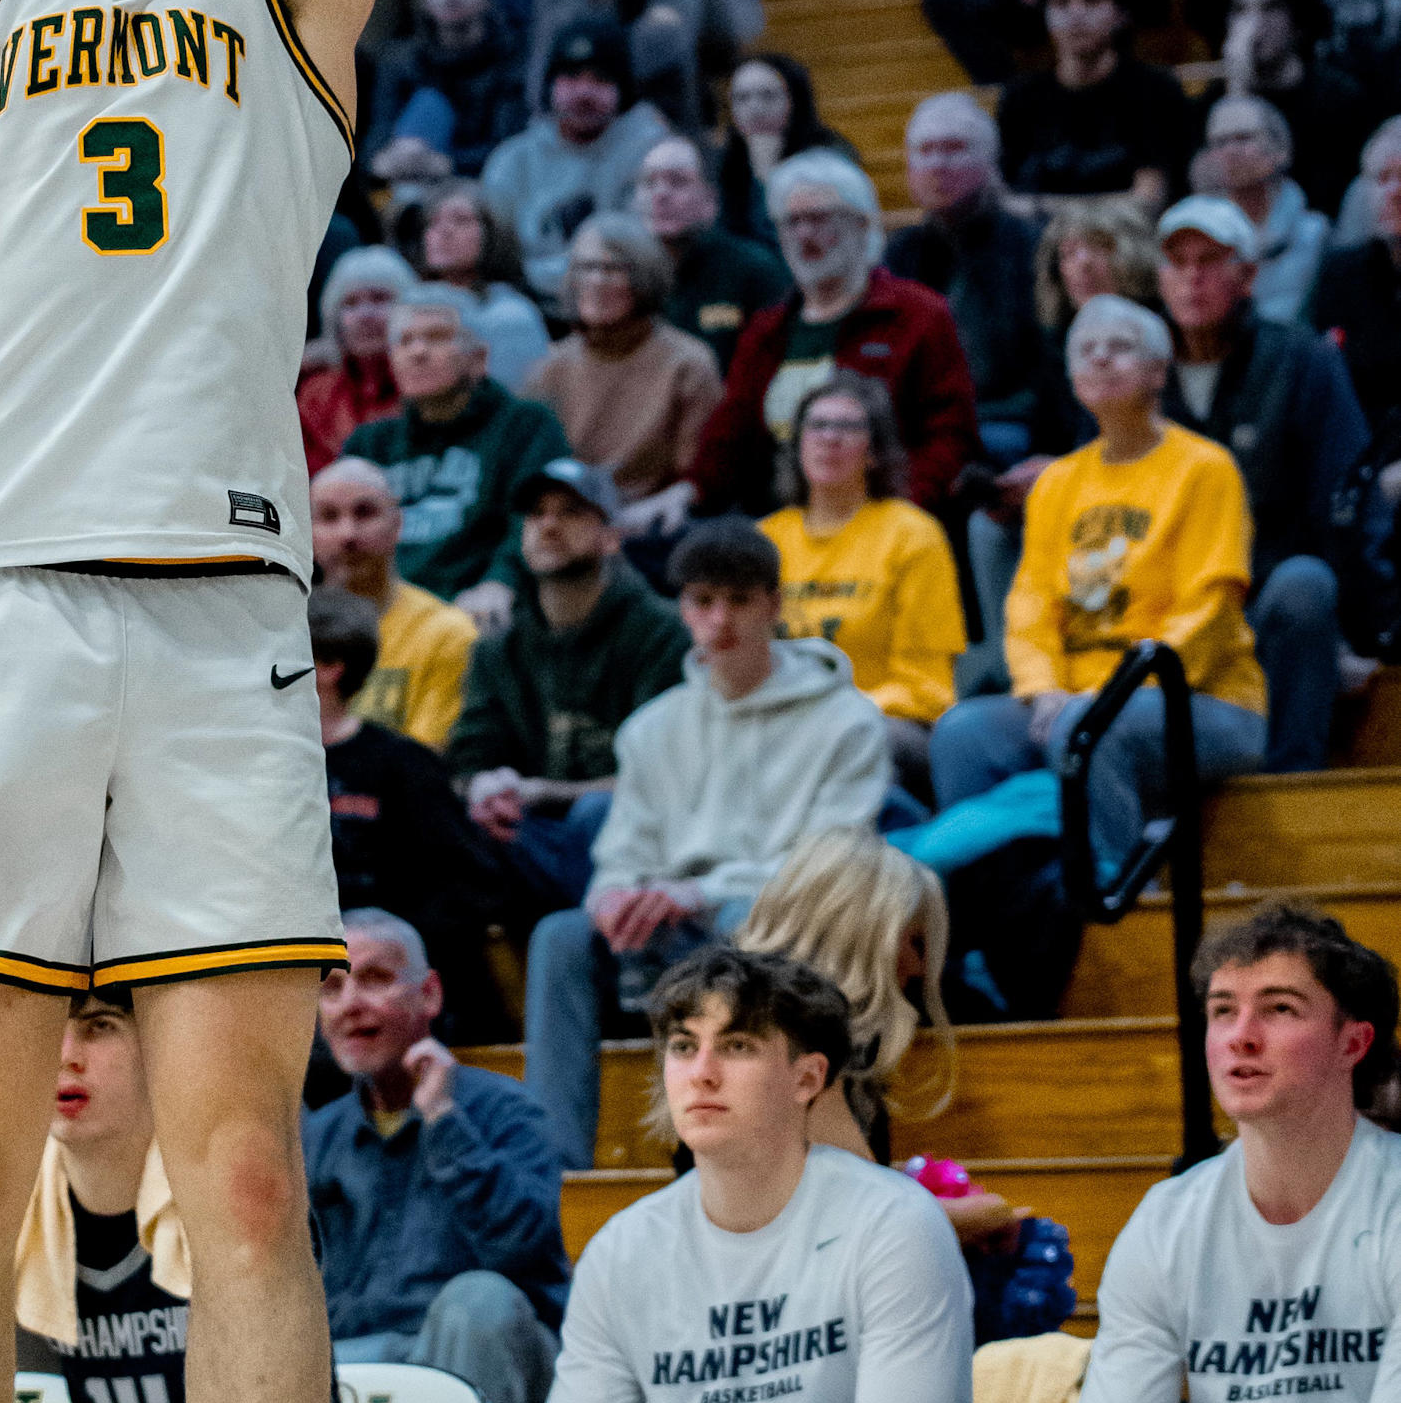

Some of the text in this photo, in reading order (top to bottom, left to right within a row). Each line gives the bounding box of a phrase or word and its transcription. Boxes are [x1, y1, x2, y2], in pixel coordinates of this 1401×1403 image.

[78, 116, 170, 256] 3
[709, 1293, 789, 1340] NEW
[652, 1317, 848, 1385] HAMPSHIRE
